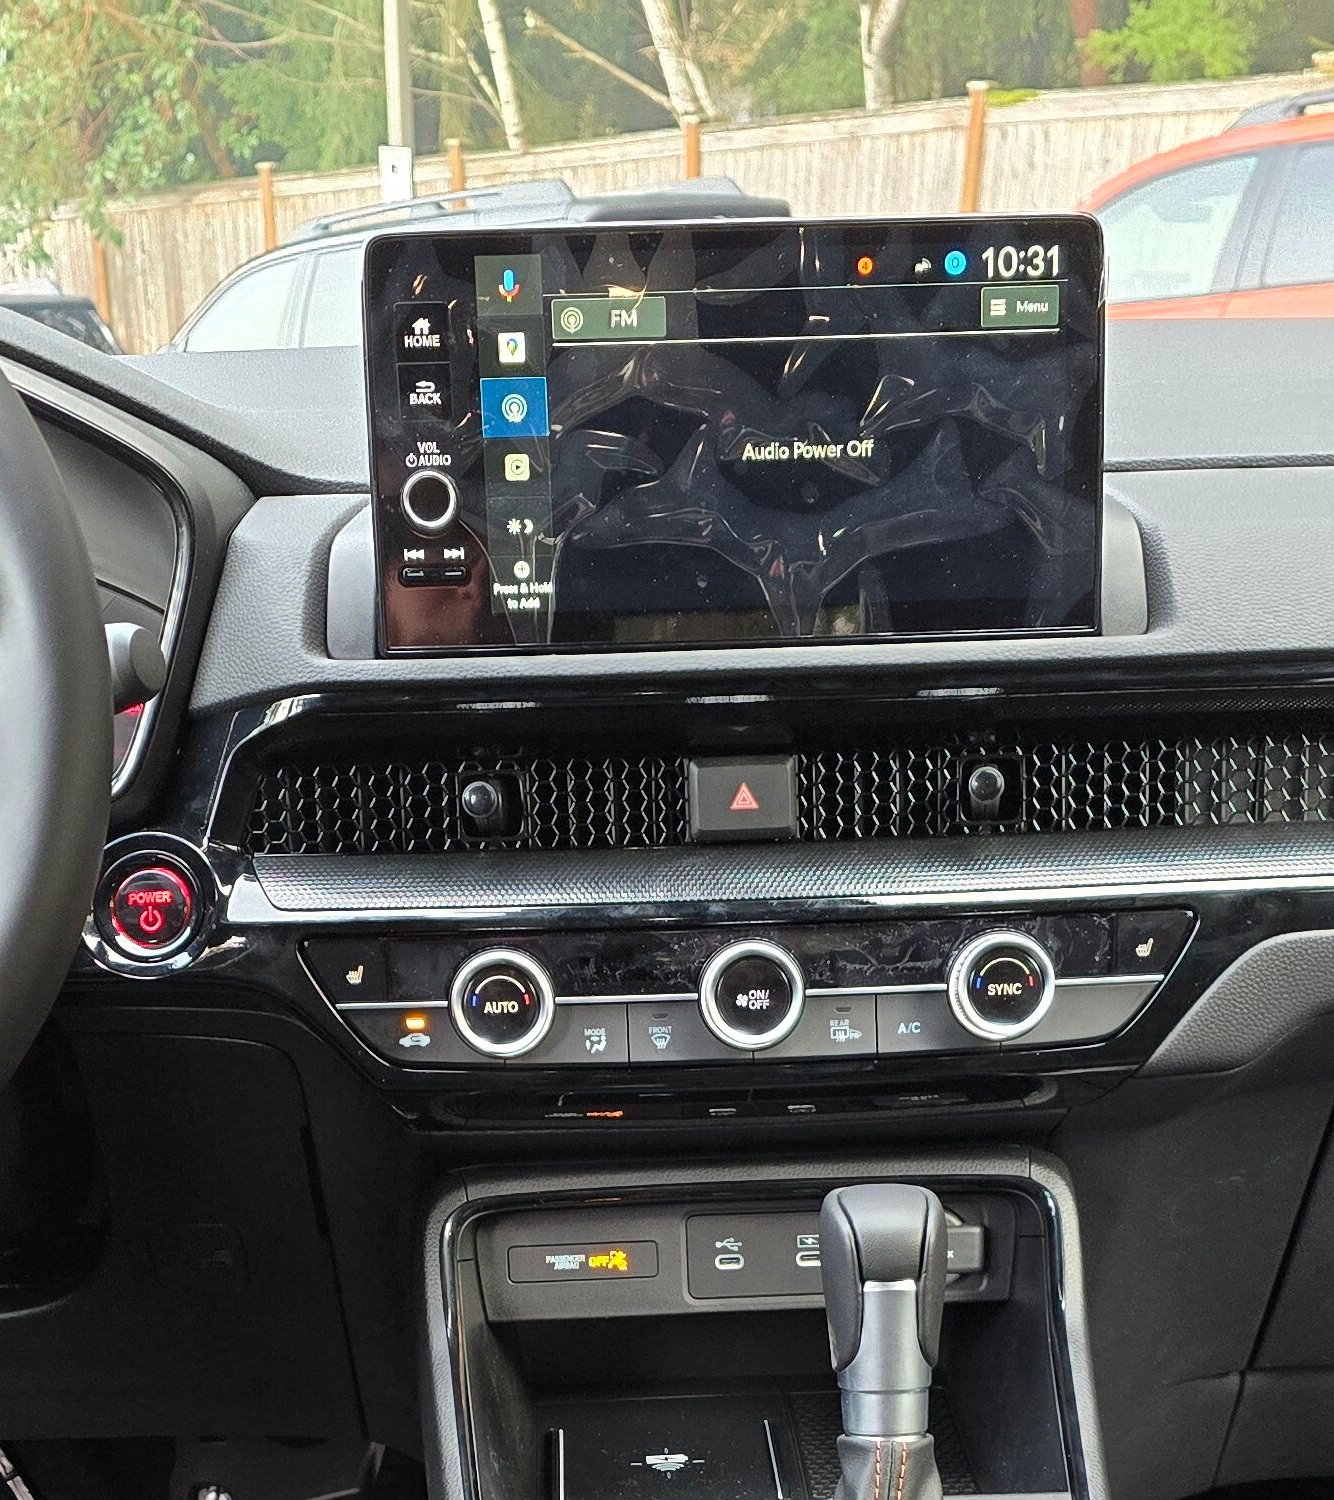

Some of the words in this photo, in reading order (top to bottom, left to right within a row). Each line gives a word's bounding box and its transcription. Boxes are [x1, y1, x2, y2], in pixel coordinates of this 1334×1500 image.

[981, 244, 1060, 280] 10:31
[1016, 299, 1049, 313] Menu
[610, 309, 638, 329] FM
[404, 334, 441, 348] HOME
[409, 392, 442, 405] BACK
[417, 441, 441, 454] VOL
[742, 442, 790, 461] Audio
[793, 440, 845, 460] Power
[846, 438, 875, 458] Off
[418, 454, 452, 467] AUDIO
[493, 583, 518, 596] Press
[529, 581, 553, 595] Hold
[507, 598, 519, 610] to
[520, 597, 541, 609] Add
[127, 890, 173, 906] POWER
[987, 982, 1023, 996] SYNC
[483, 1000, 519, 1014] AUTO
[748, 999, 770, 1010] OFF
[829, 1018, 850, 1027] REAR
[897, 1021, 922, 1035] A/C
[583, 1027, 606, 1037] MODE
[648, 1025, 673, 1035] FRONT
